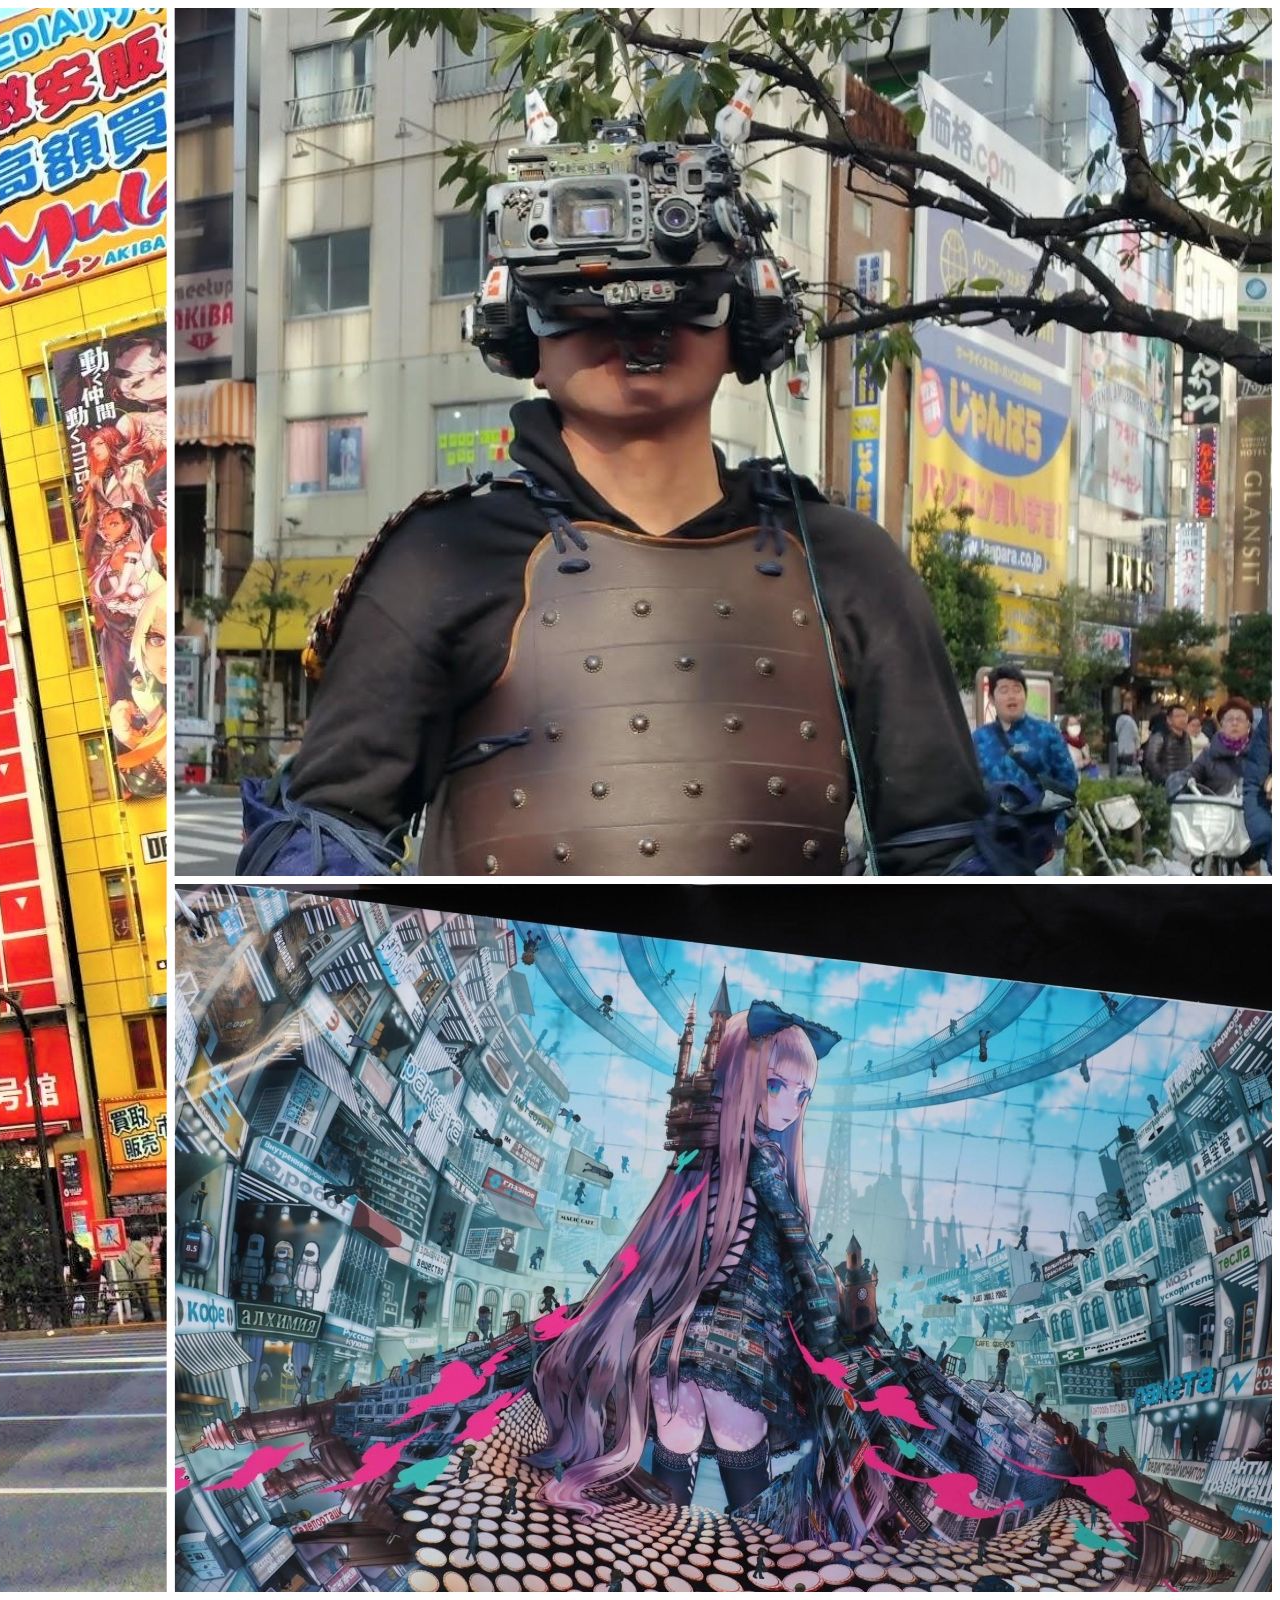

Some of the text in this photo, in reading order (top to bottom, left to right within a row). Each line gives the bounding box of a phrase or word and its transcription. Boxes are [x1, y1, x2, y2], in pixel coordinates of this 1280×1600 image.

[929, 98, 1016, 194] 価格.com
[22, 237, 166, 291] ムーラン AKIBA
[949, 376, 1042, 463] じゃんぱら
[65, 405, 90, 493] 動くココロ。
[1241, 470, 1263, 586] GLANSIT
[1228, 1015, 1261, 1056] аптека
[109, 1104, 149, 1134] 買取
[124, 1134, 160, 1160] 販売
[1201, 1131, 1232, 1170] 真空管
[1216, 1245, 1251, 1273] тесла
[1160, 1272, 1216, 1302] ускоритель
[240, 1306, 318, 1334] алхимия
